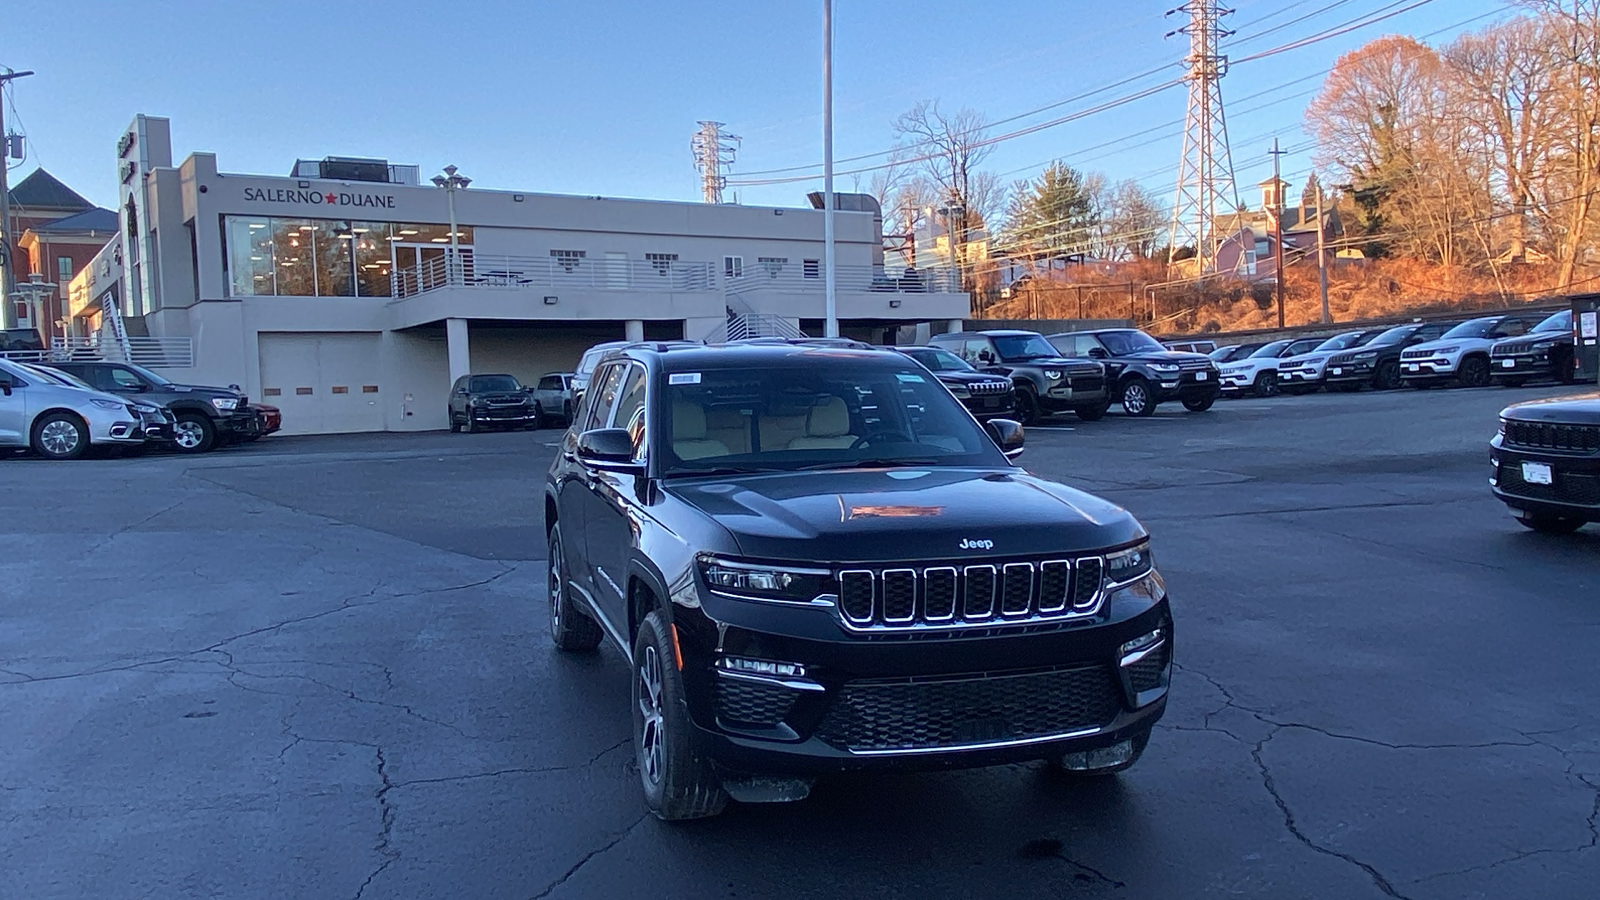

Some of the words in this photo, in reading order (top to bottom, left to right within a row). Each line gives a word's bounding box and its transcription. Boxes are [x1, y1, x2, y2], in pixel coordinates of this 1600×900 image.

[244, 187, 323, 205] SALERNO
[339, 193, 396, 209] DUANE
[959, 538, 994, 550] Jeep
